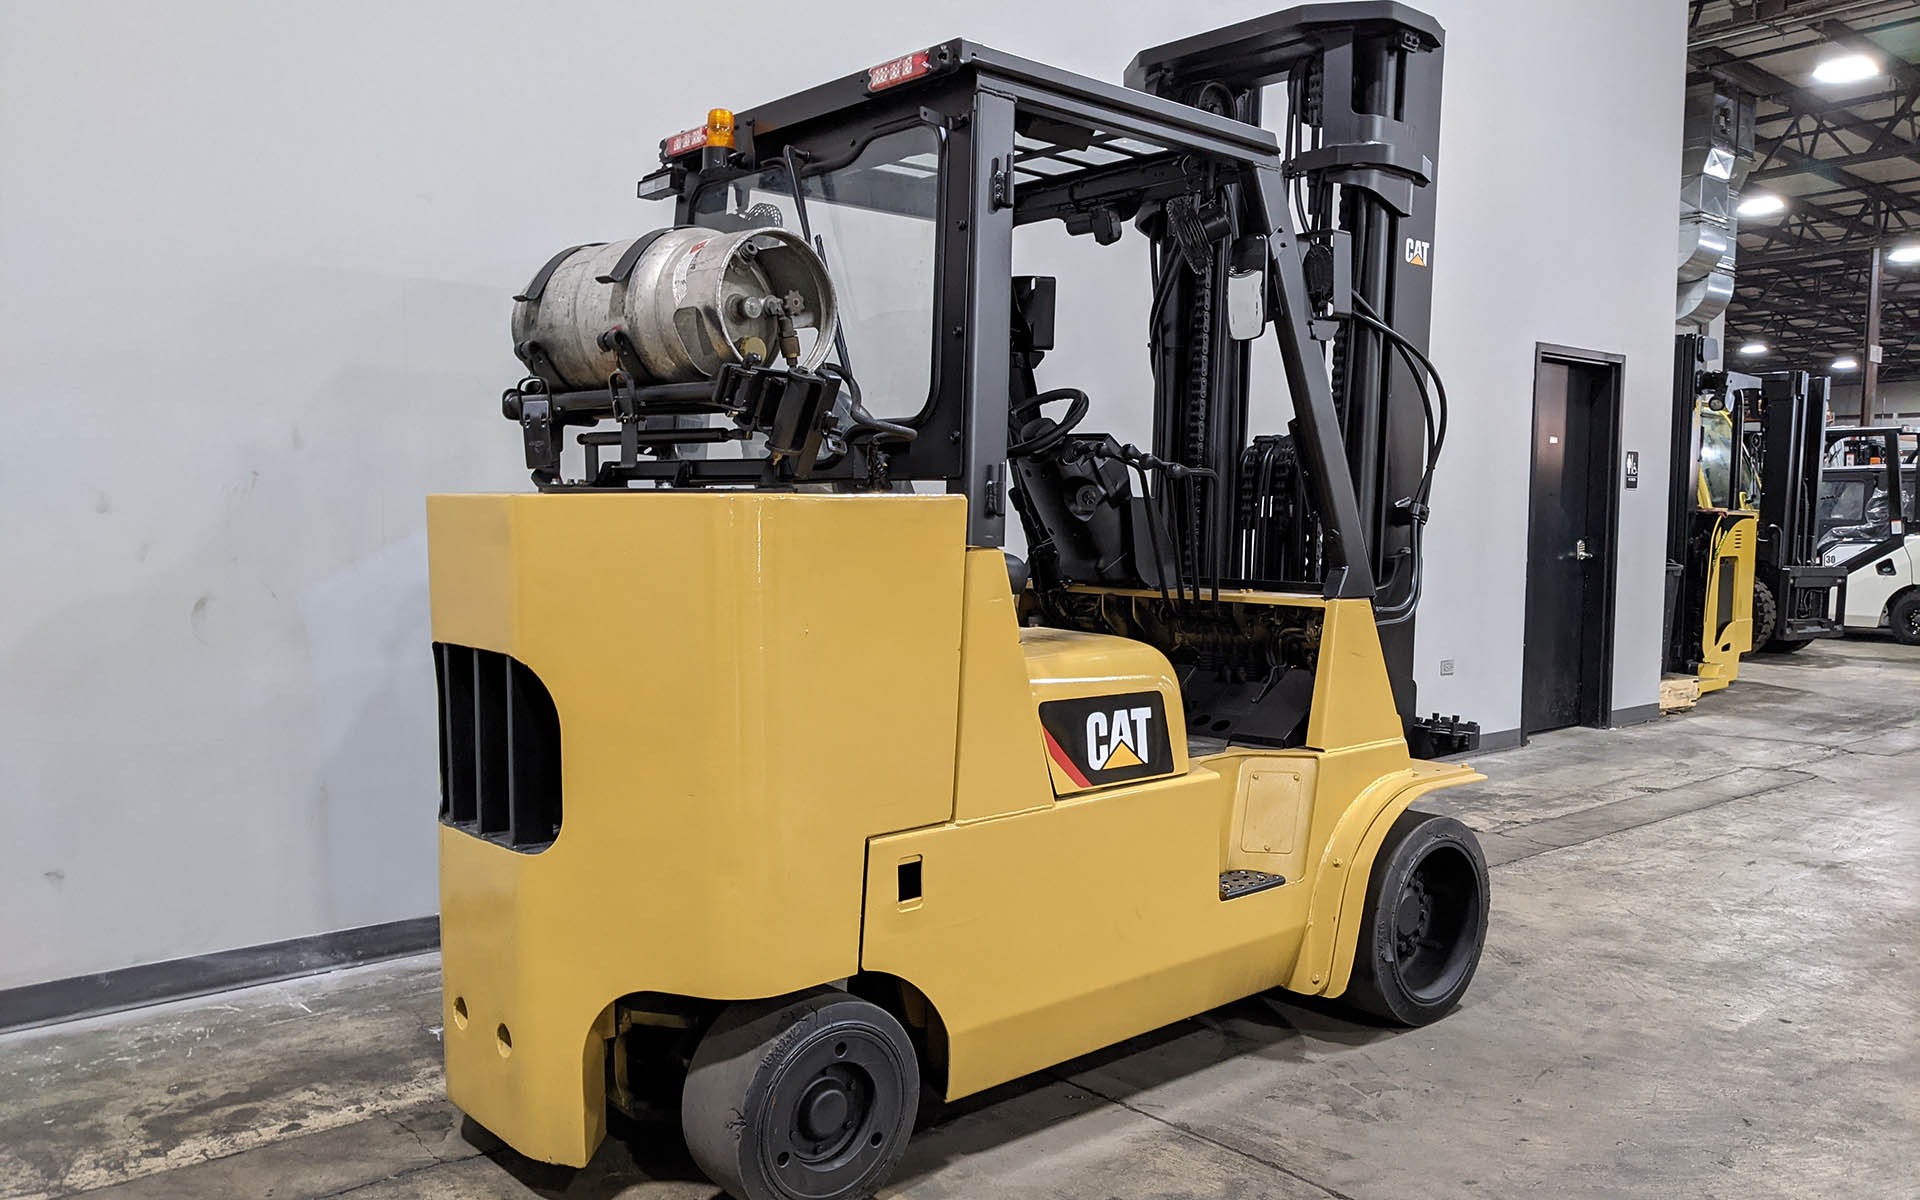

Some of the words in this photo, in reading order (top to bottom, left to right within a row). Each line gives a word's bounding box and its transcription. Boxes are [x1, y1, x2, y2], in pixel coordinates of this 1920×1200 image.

[1405, 238, 1430, 267] CAT
[1826, 555, 1836, 564] 30
[1086, 707, 1152, 771] CAT
